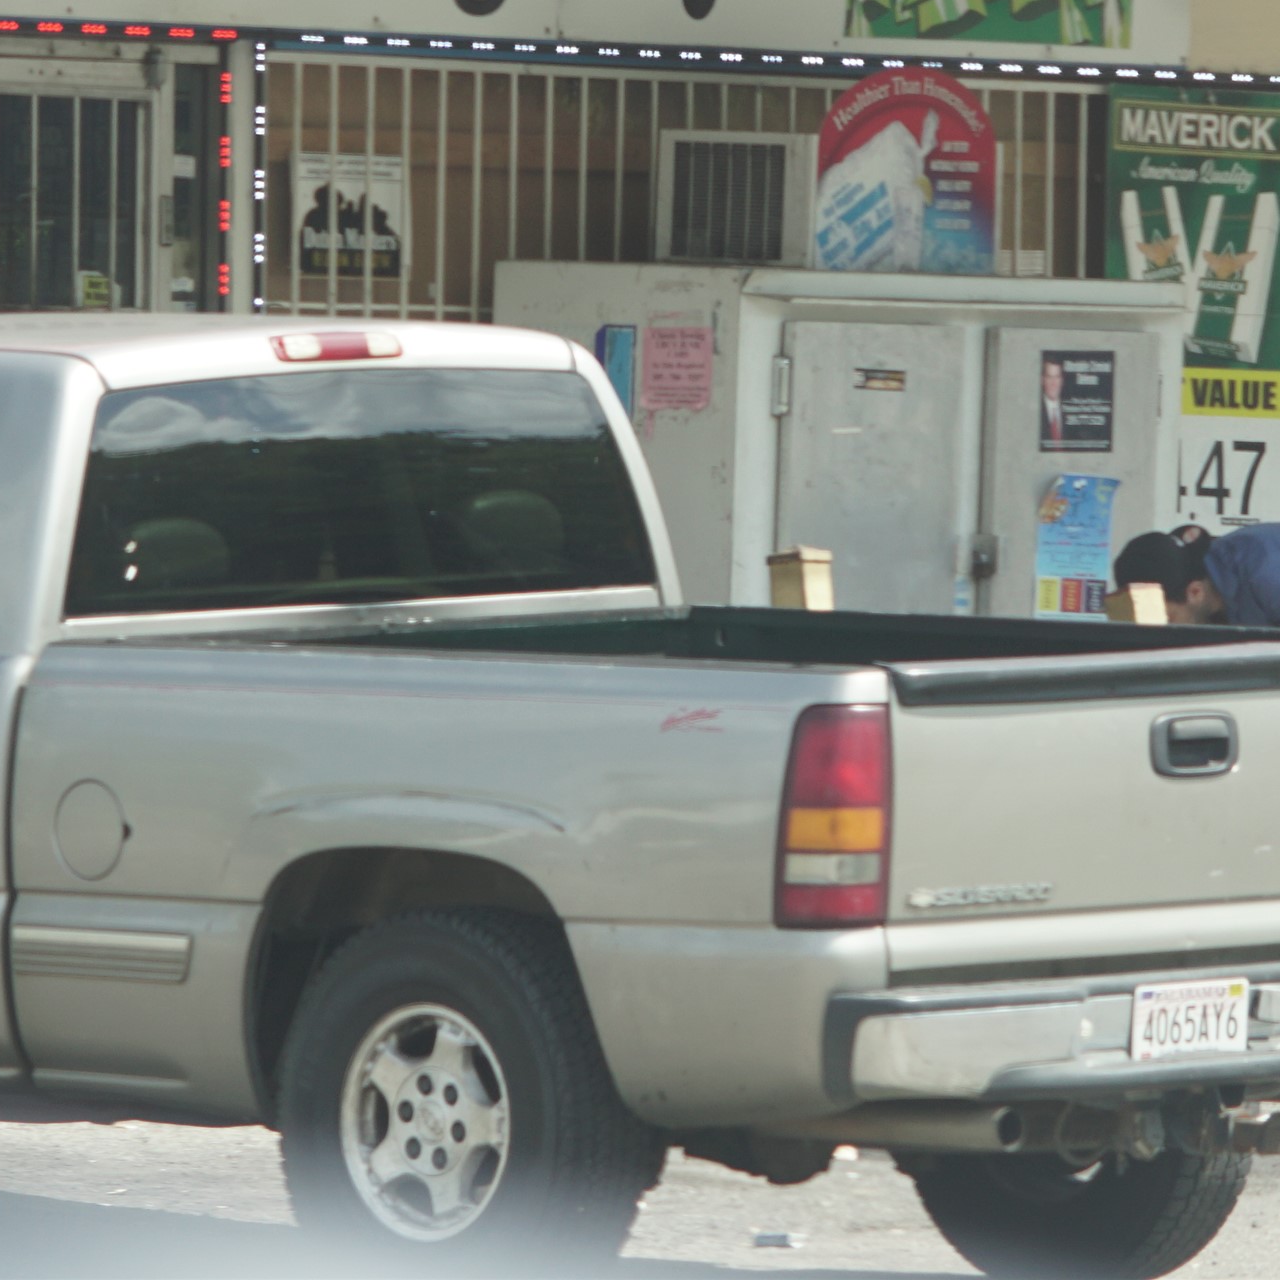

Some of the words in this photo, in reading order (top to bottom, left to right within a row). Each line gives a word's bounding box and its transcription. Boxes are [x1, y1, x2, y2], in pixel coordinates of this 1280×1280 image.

[892, 76, 920, 95] Than
[1120, 107, 1278, 151] MAVERICK
[1191, 378, 1277, 411] VALUE
[1143, 1002, 1238, 1046] 4065AY6
